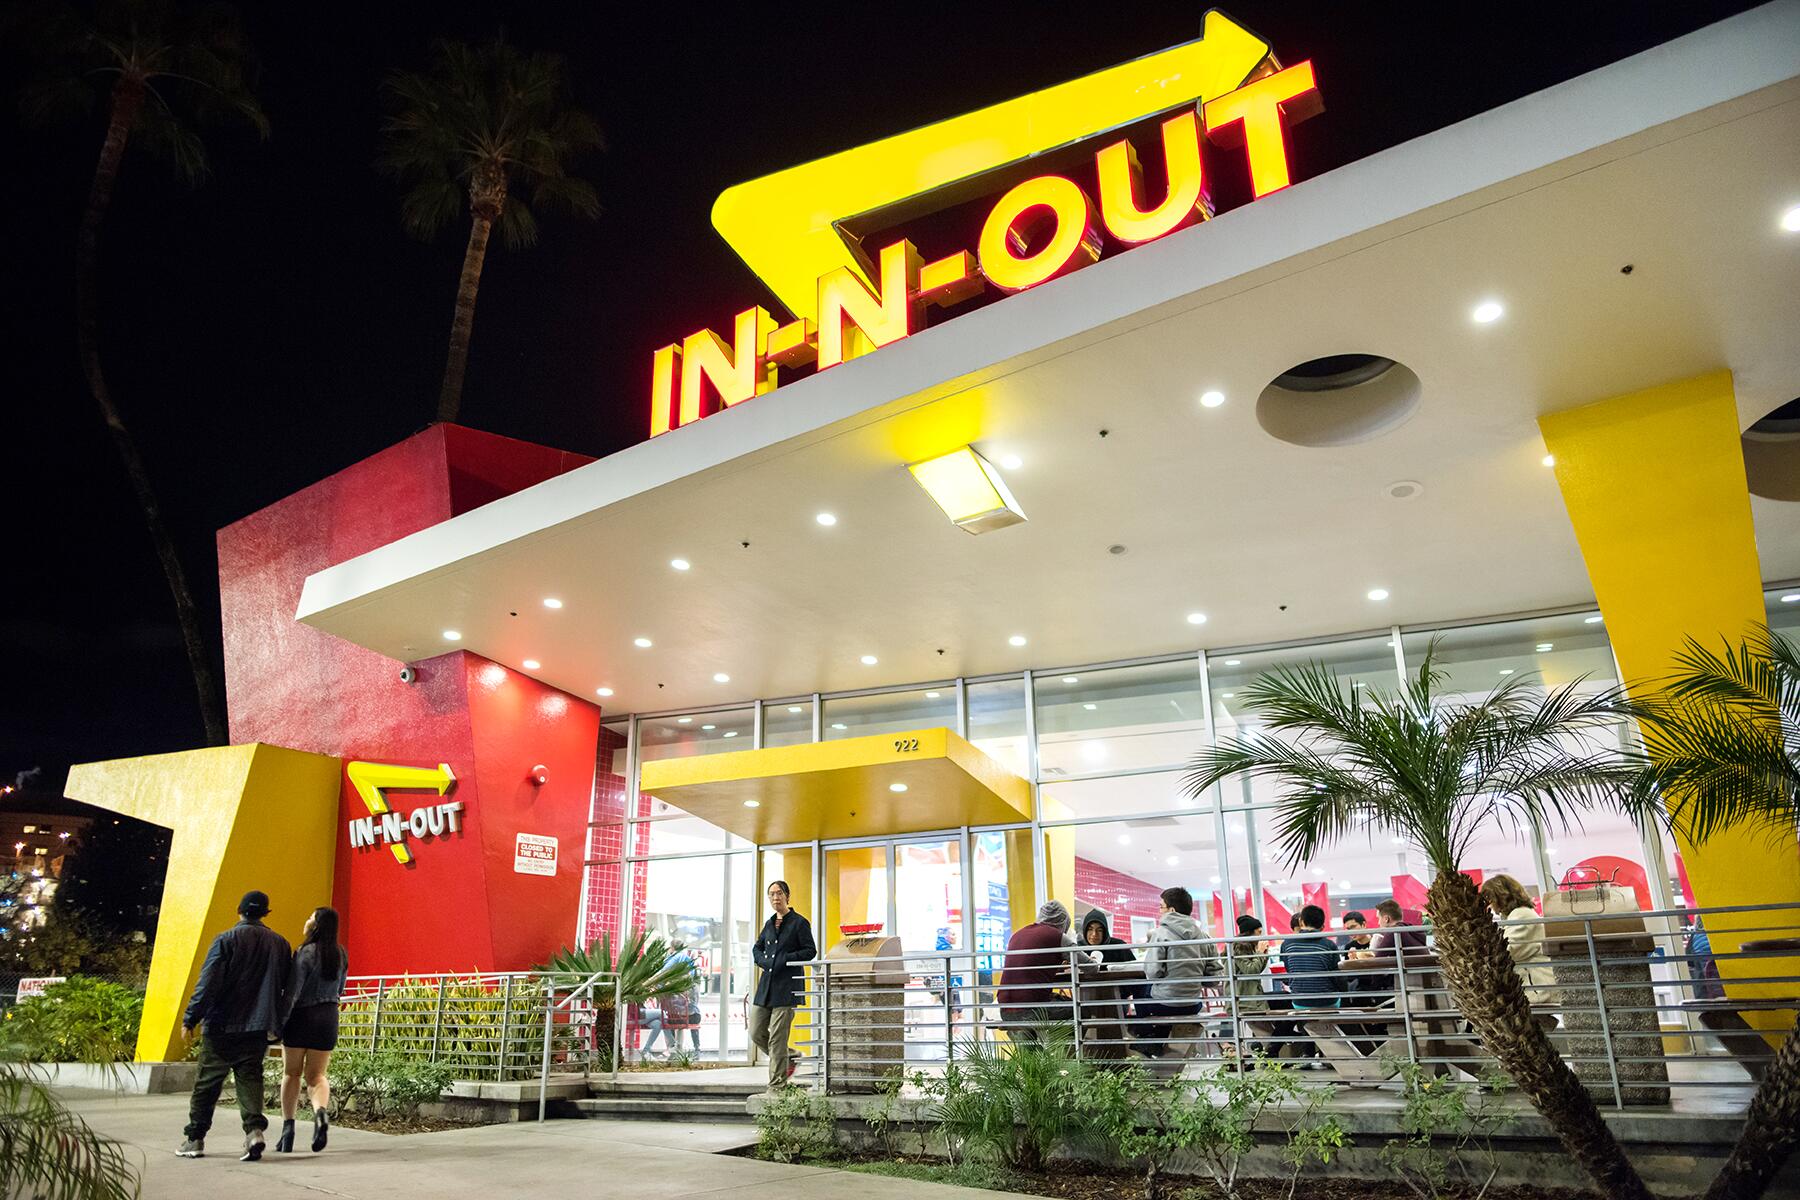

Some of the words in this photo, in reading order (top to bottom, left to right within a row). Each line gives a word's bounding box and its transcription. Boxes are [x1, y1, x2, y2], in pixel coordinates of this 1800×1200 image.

[650, 59, 1317, 439] IN-N-OUT
[894, 738, 919, 752] 922
[349, 801, 463, 848] IN-N-OUT
[533, 851, 553, 859] PUBLIC
